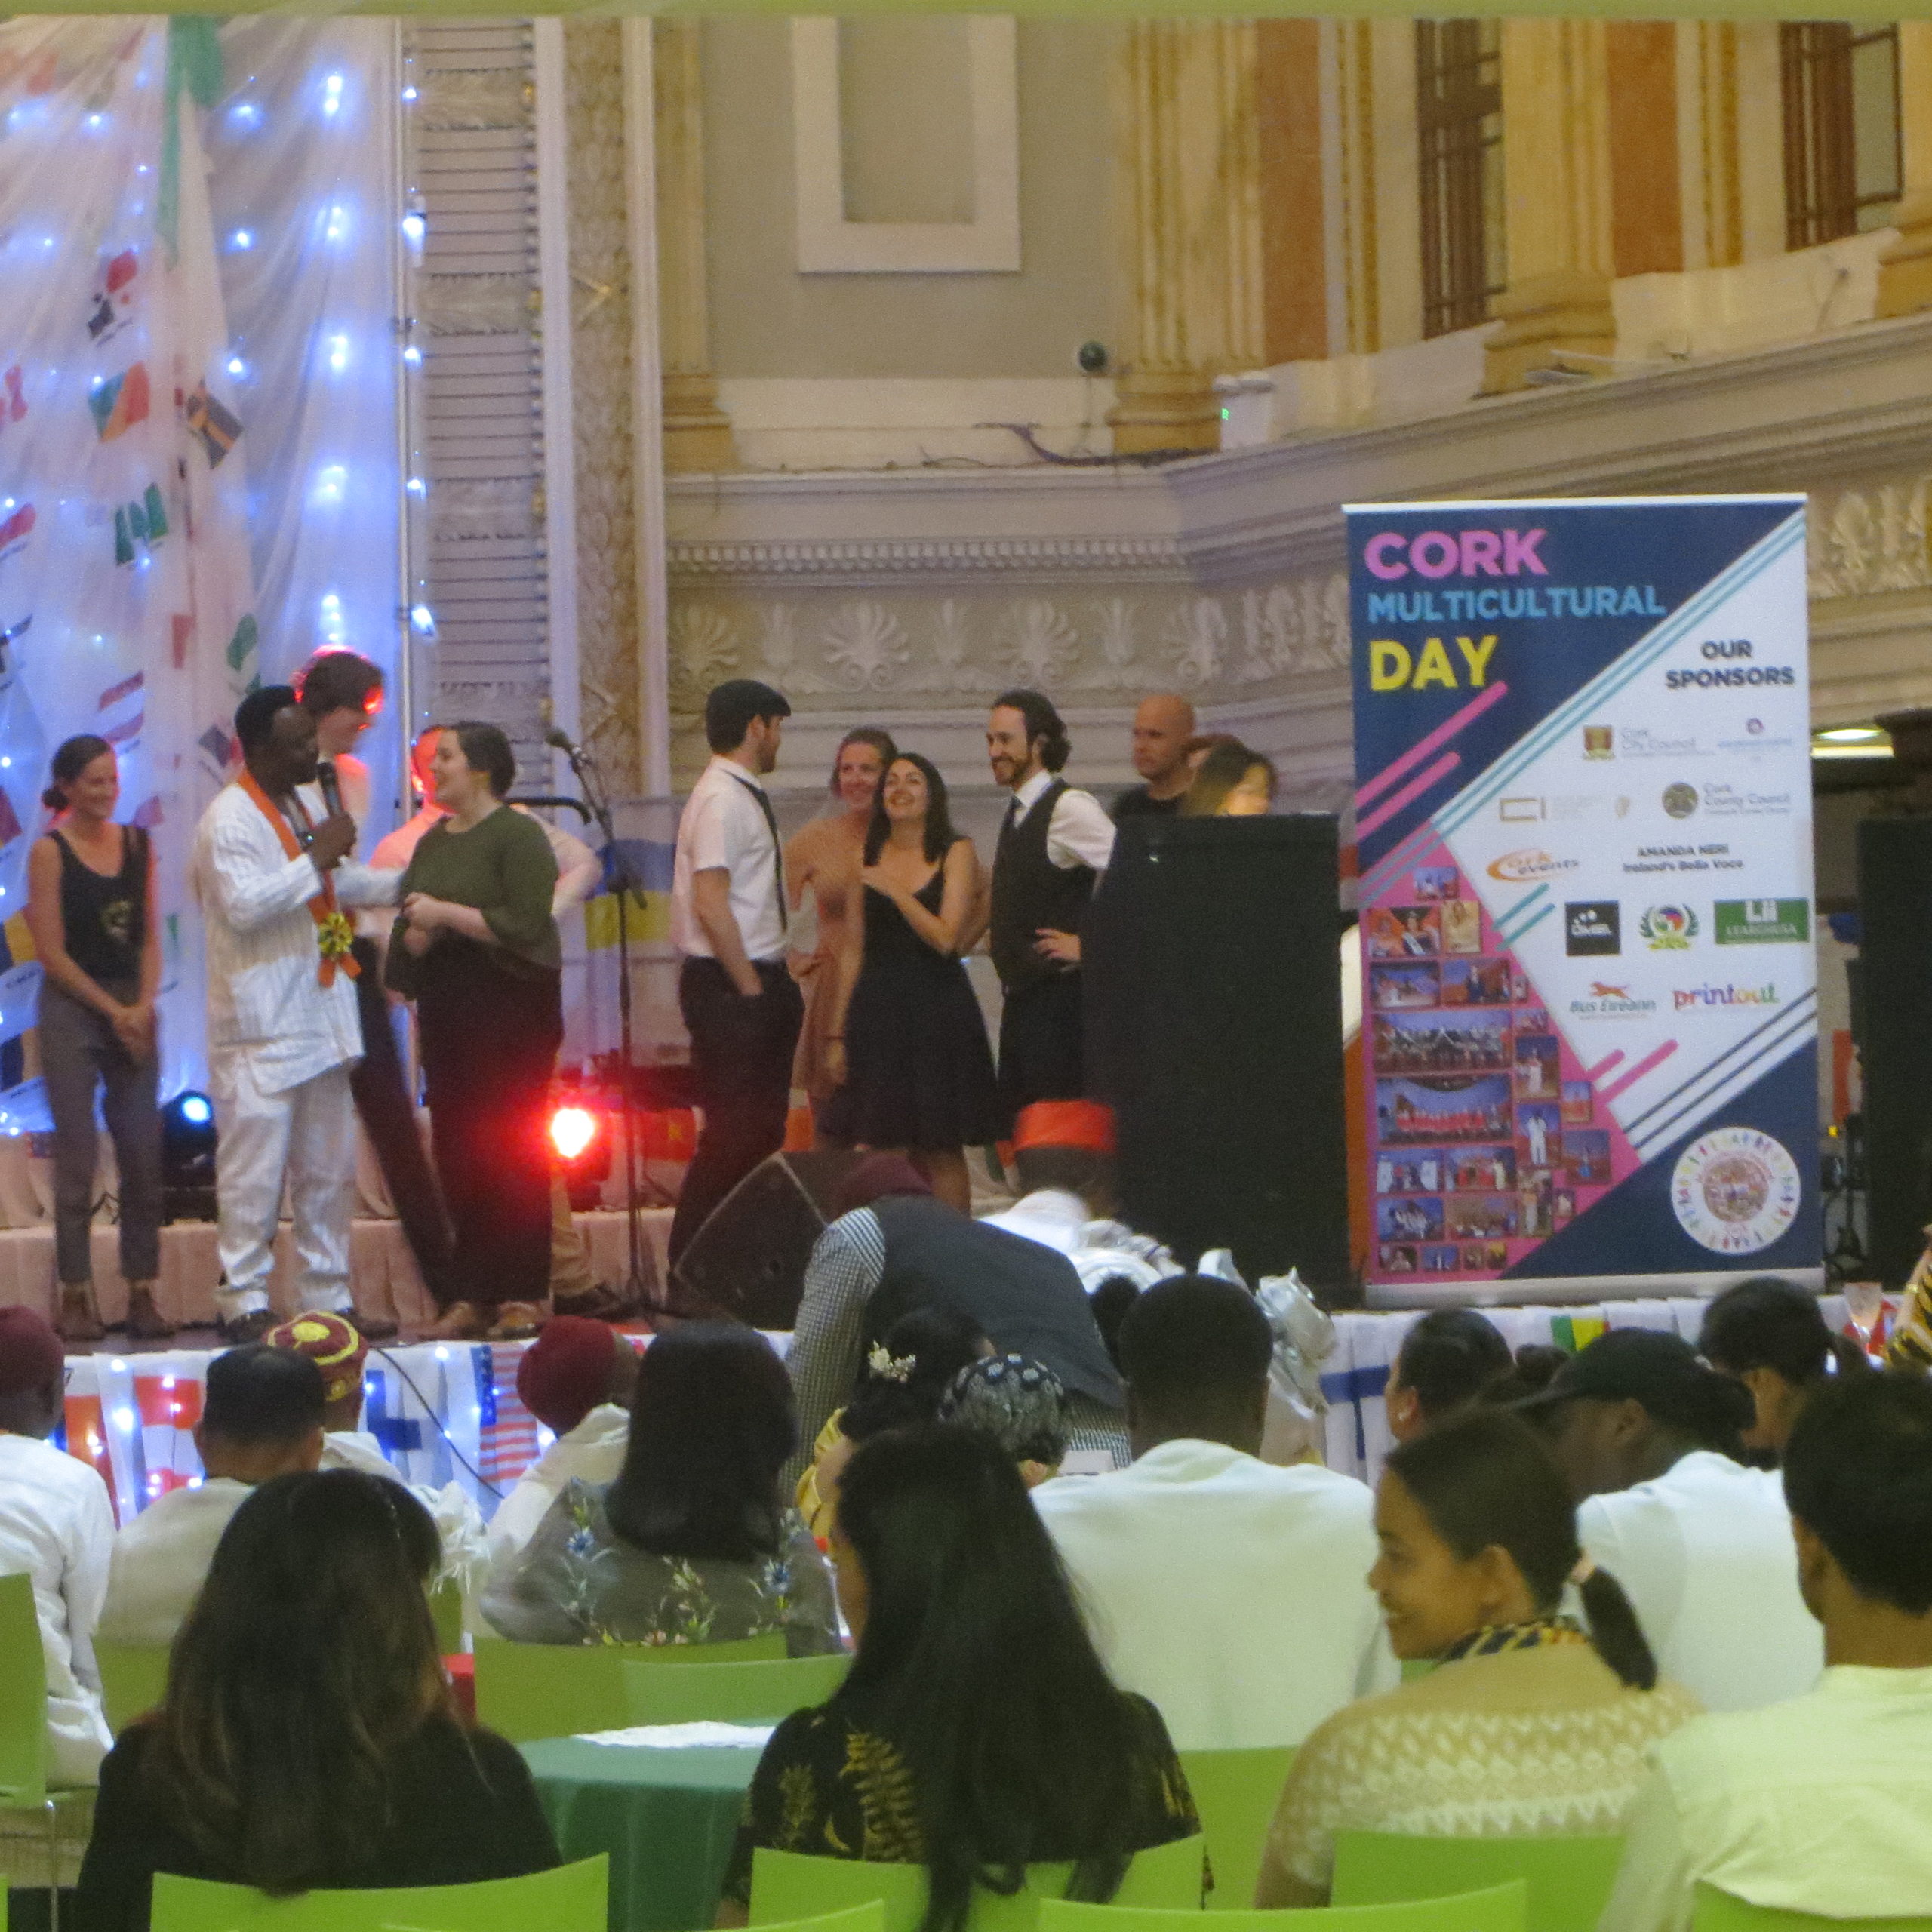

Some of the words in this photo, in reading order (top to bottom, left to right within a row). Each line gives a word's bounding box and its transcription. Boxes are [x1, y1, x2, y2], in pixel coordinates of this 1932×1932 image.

[1364, 529, 1549, 580] CORK
[1367, 586, 1666, 624] MULTICULTURAL
[1369, 635, 1500, 692] DAY
[1701, 639, 1752, 659] OUR
[1666, 666, 1795, 690] SPONSORS
[1637, 845, 1696, 857] AMANDA
